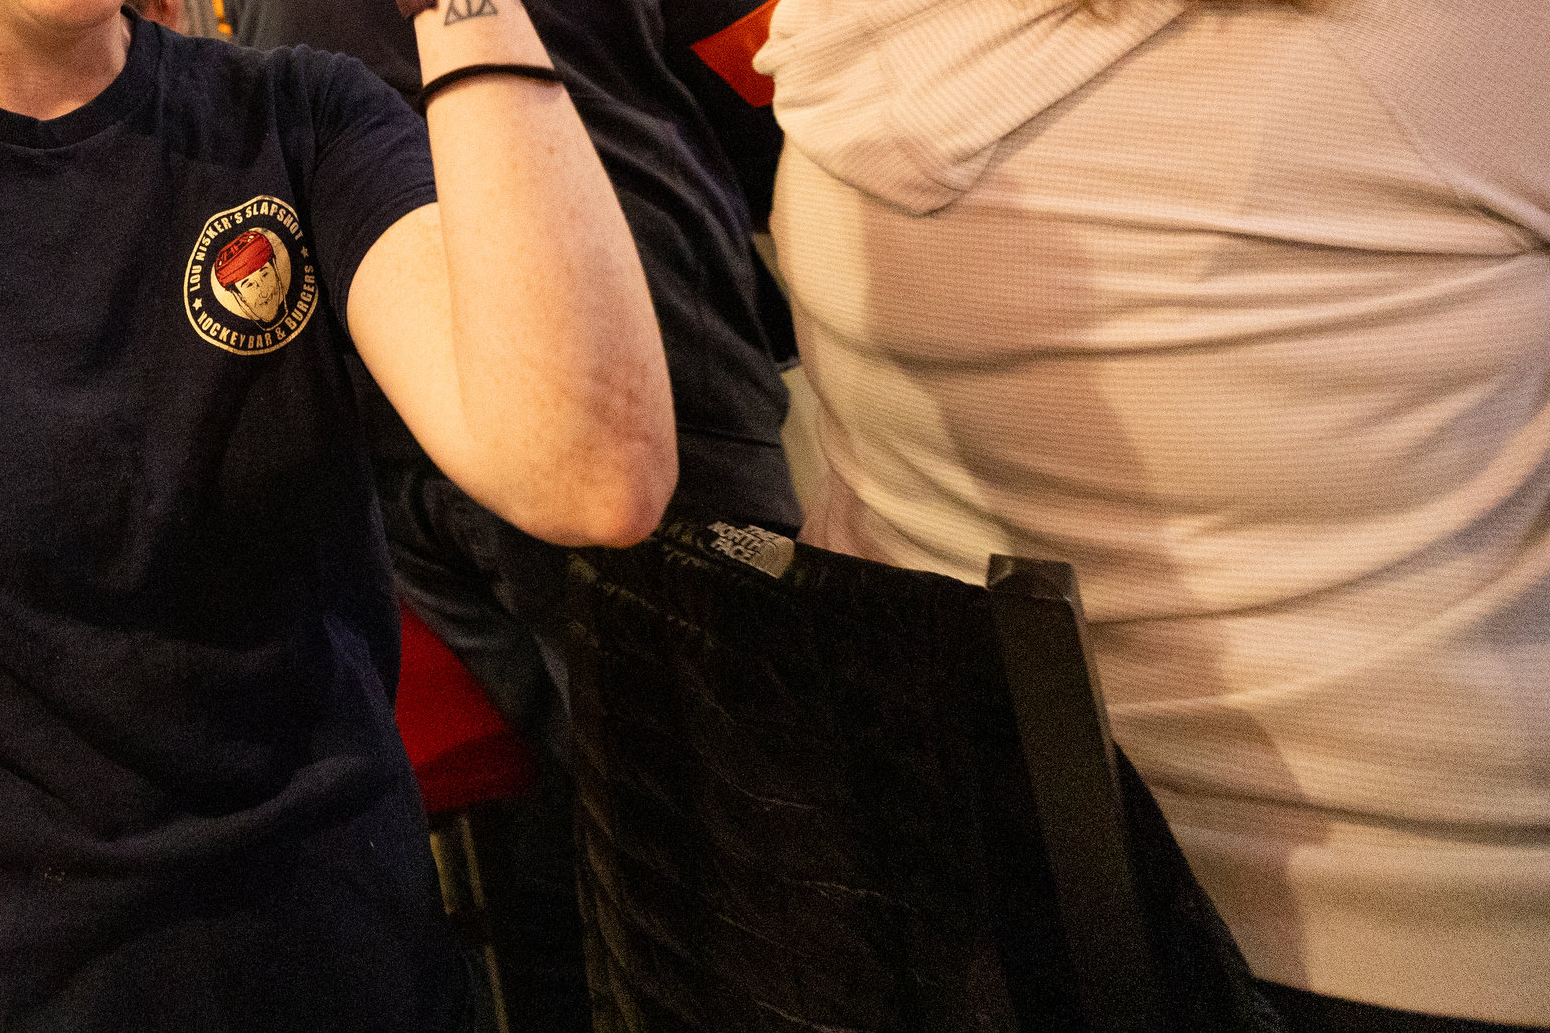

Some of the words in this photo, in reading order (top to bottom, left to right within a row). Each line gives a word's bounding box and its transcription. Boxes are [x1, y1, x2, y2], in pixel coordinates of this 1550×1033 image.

[195, 212, 244, 261] NISKER'S
[245, 202, 303, 240] SLAPSHOT
[190, 265, 202, 292] LOU
[197, 311, 244, 347] HOCKEY
[248, 332, 273, 349] BAR
[275, 327, 286, 340] &
[284, 265, 315, 331] BURGERS
[707, 521, 763, 550] NORTH
[710, 536, 761, 561] FACE
